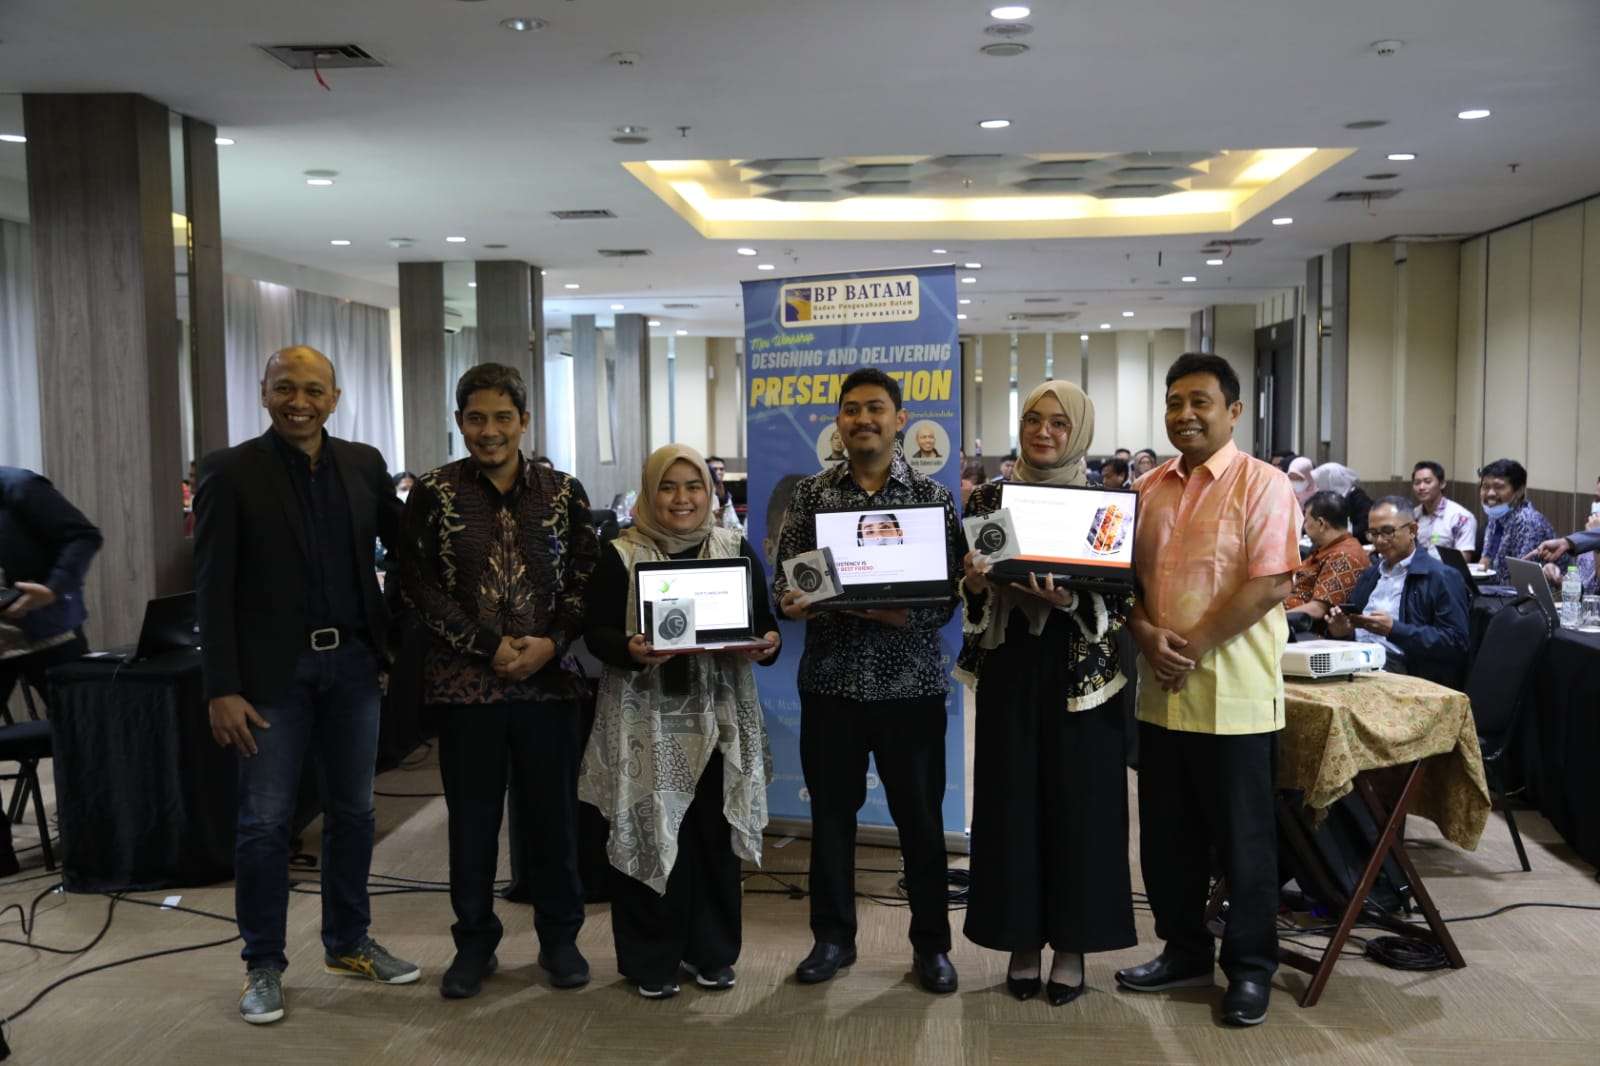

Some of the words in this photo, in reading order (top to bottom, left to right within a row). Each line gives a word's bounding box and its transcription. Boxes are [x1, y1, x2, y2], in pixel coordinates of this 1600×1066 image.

[815, 287, 837, 302] BP
[846, 281, 912, 300] BATAM
[752, 350, 821, 369] DESIGNING
[827, 347, 856, 366] AND
[861, 345, 950, 364] DELIVERING
[750, 369, 952, 408] PRESENION
